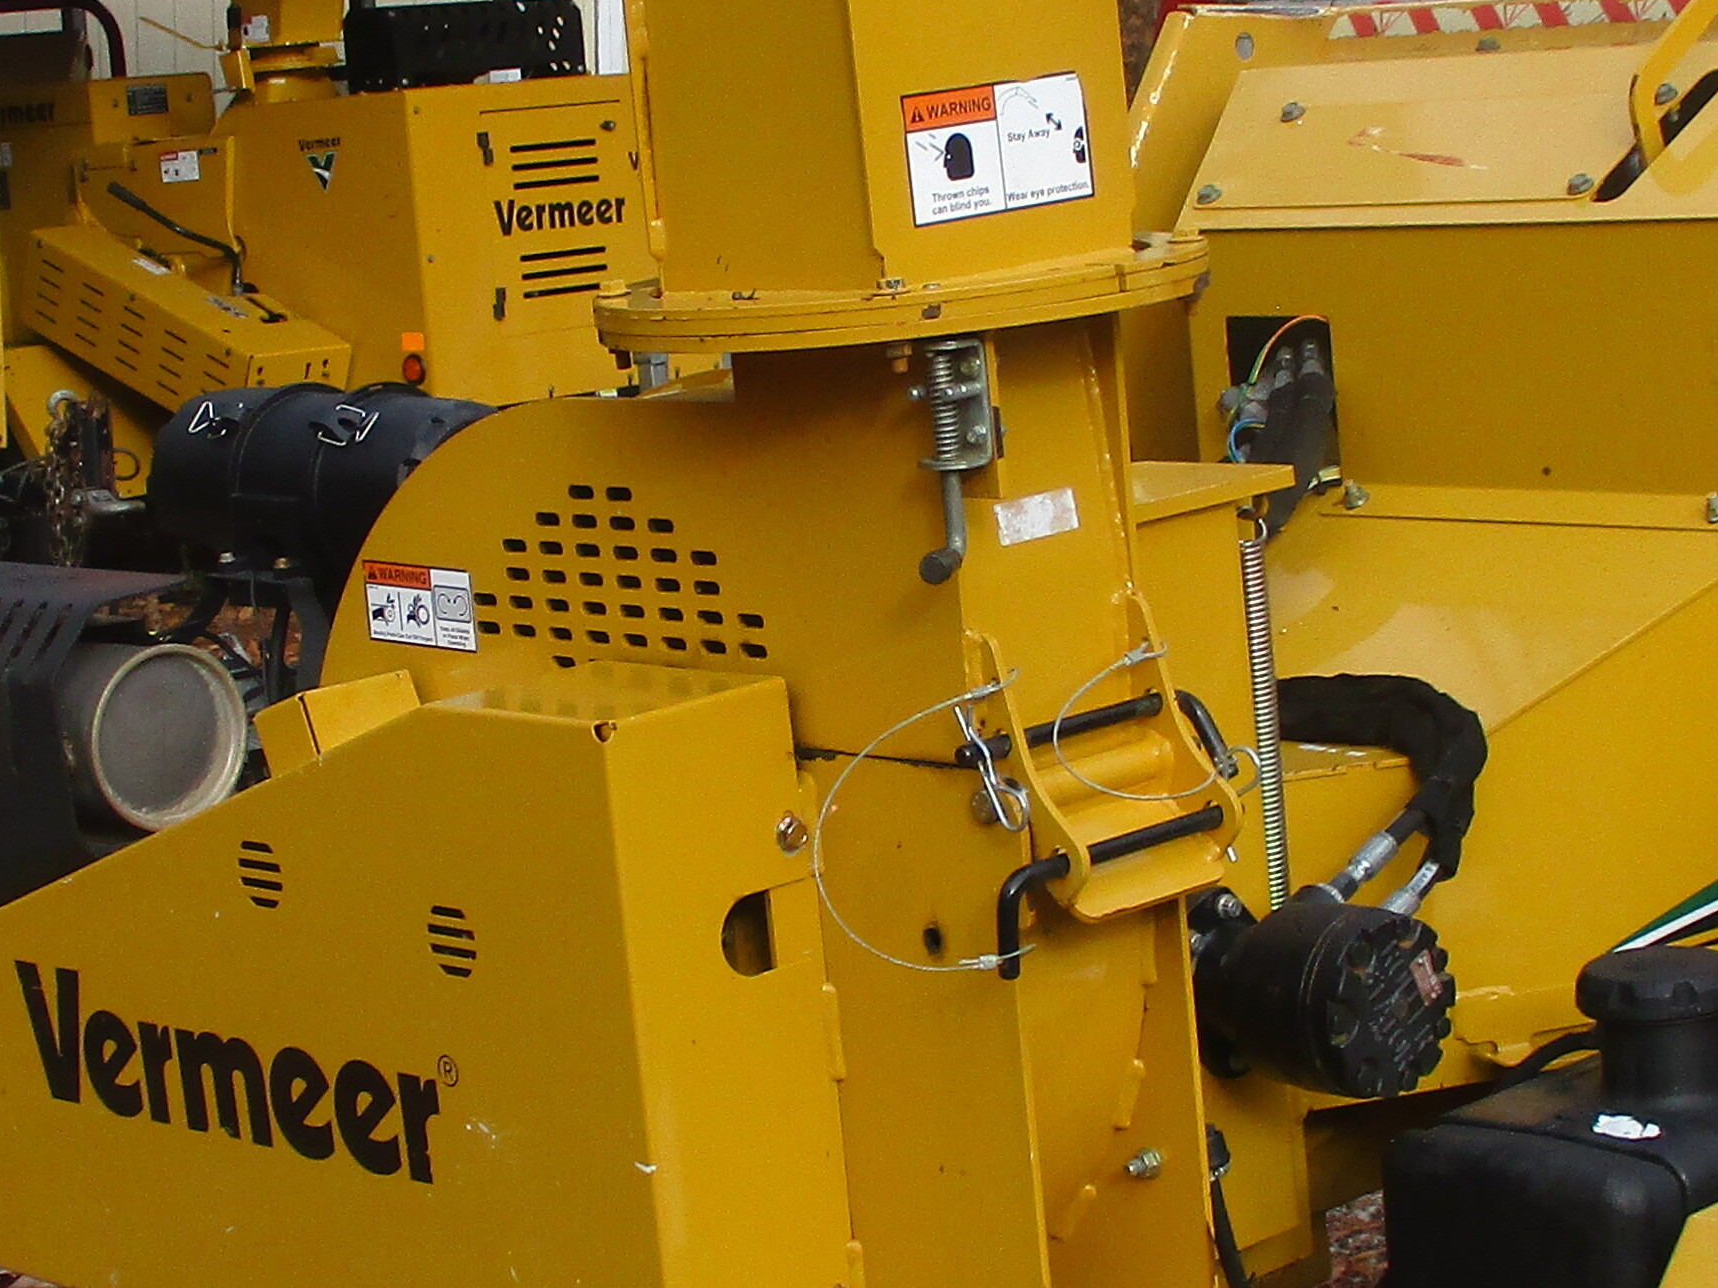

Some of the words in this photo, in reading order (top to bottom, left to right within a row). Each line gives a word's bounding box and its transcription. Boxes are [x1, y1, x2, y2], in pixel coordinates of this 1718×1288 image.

[925, 96, 992, 120] WARNING
[298, 137, 341, 151] Vermeer
[1007, 131, 1027, 143] Stay
[1028, 128, 1050, 140] Away
[932, 190, 965, 203] Thrown
[966, 186, 990, 199] chips
[1006, 192, 1028, 203] Wear
[1030, 189, 1045, 200] eye
[1047, 181, 1090, 197] protection.
[932, 205, 948, 216] can
[950, 199, 972, 213] blind
[493, 197, 626, 236] Vermeer
[379, 568, 428, 585] WARNING
[14, 959, 441, 1184] Vermeer
